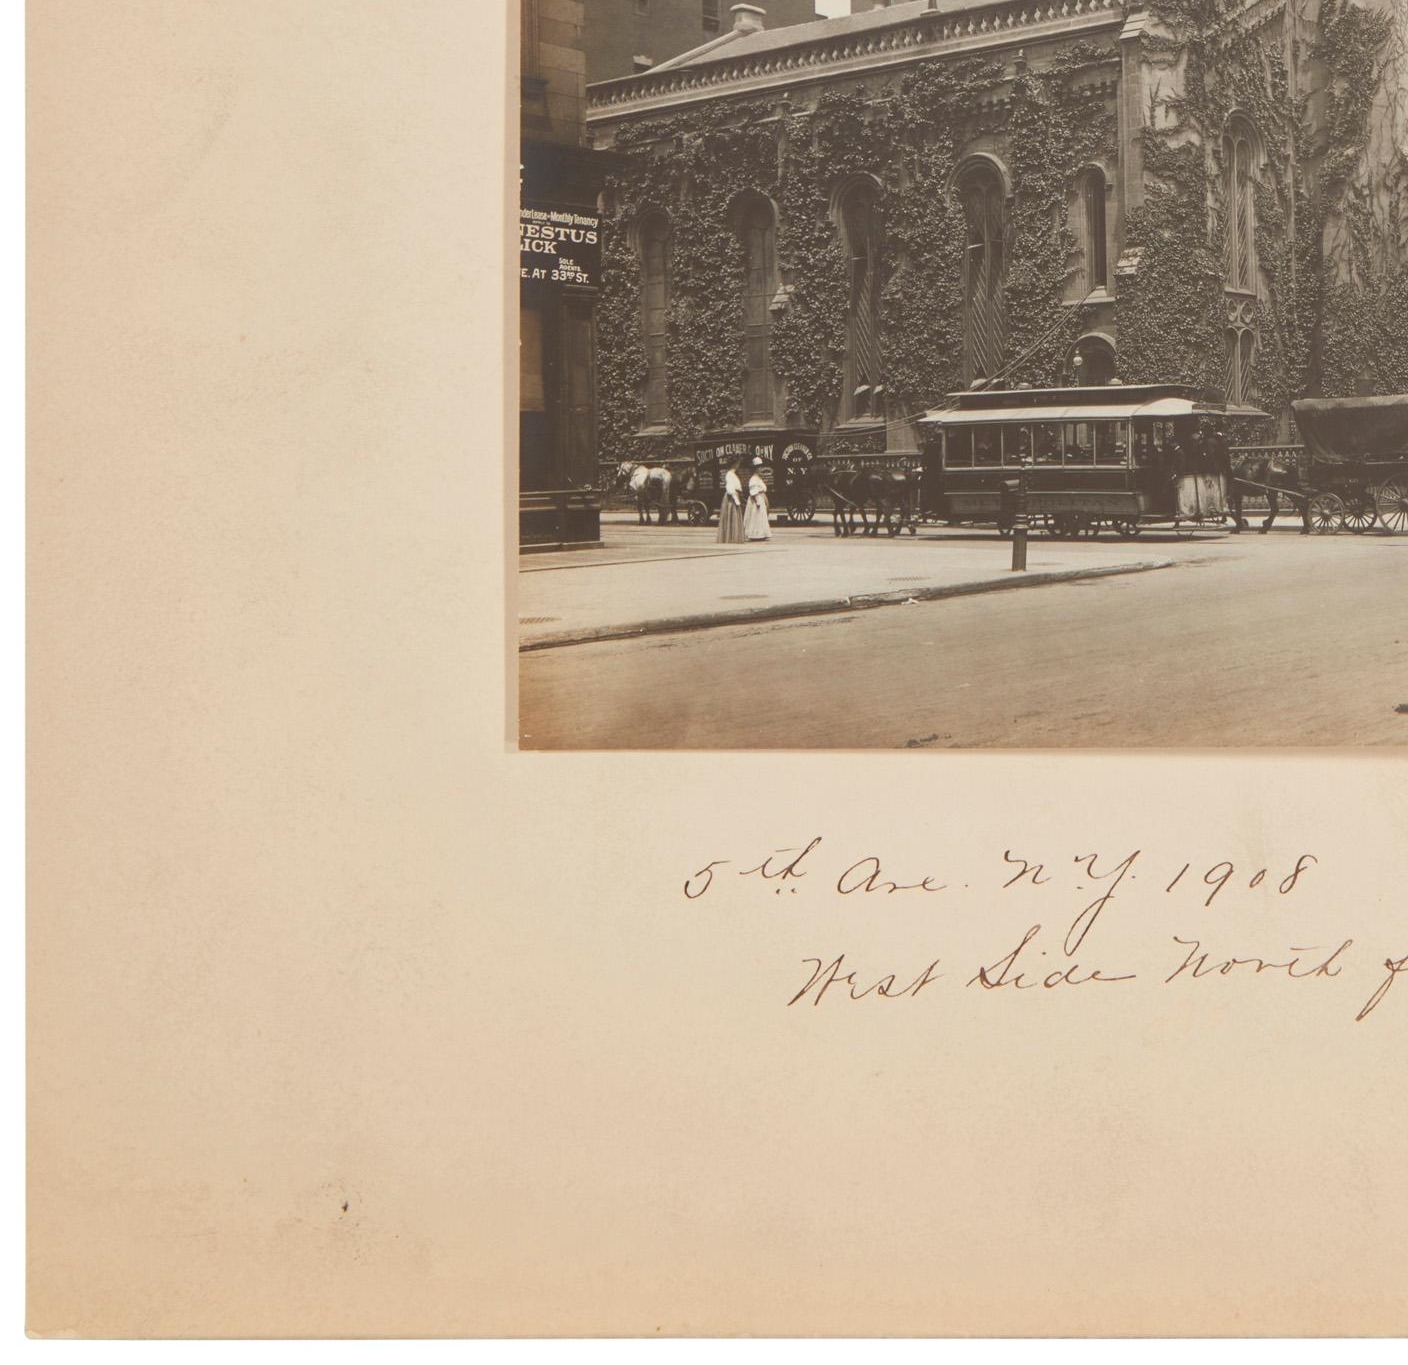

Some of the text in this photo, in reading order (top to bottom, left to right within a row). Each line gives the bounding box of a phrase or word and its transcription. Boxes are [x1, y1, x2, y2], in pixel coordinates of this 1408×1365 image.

[574, 214, 599, 228] Tenancy
[532, 269, 547, 280] AT
[577, 273, 591, 285] ST.
[1165, 854, 1319, 908] 1908
[786, 953, 944, 1007] West
[965, 923, 1138, 990] Side
[1164, 935, 1353, 984] North
